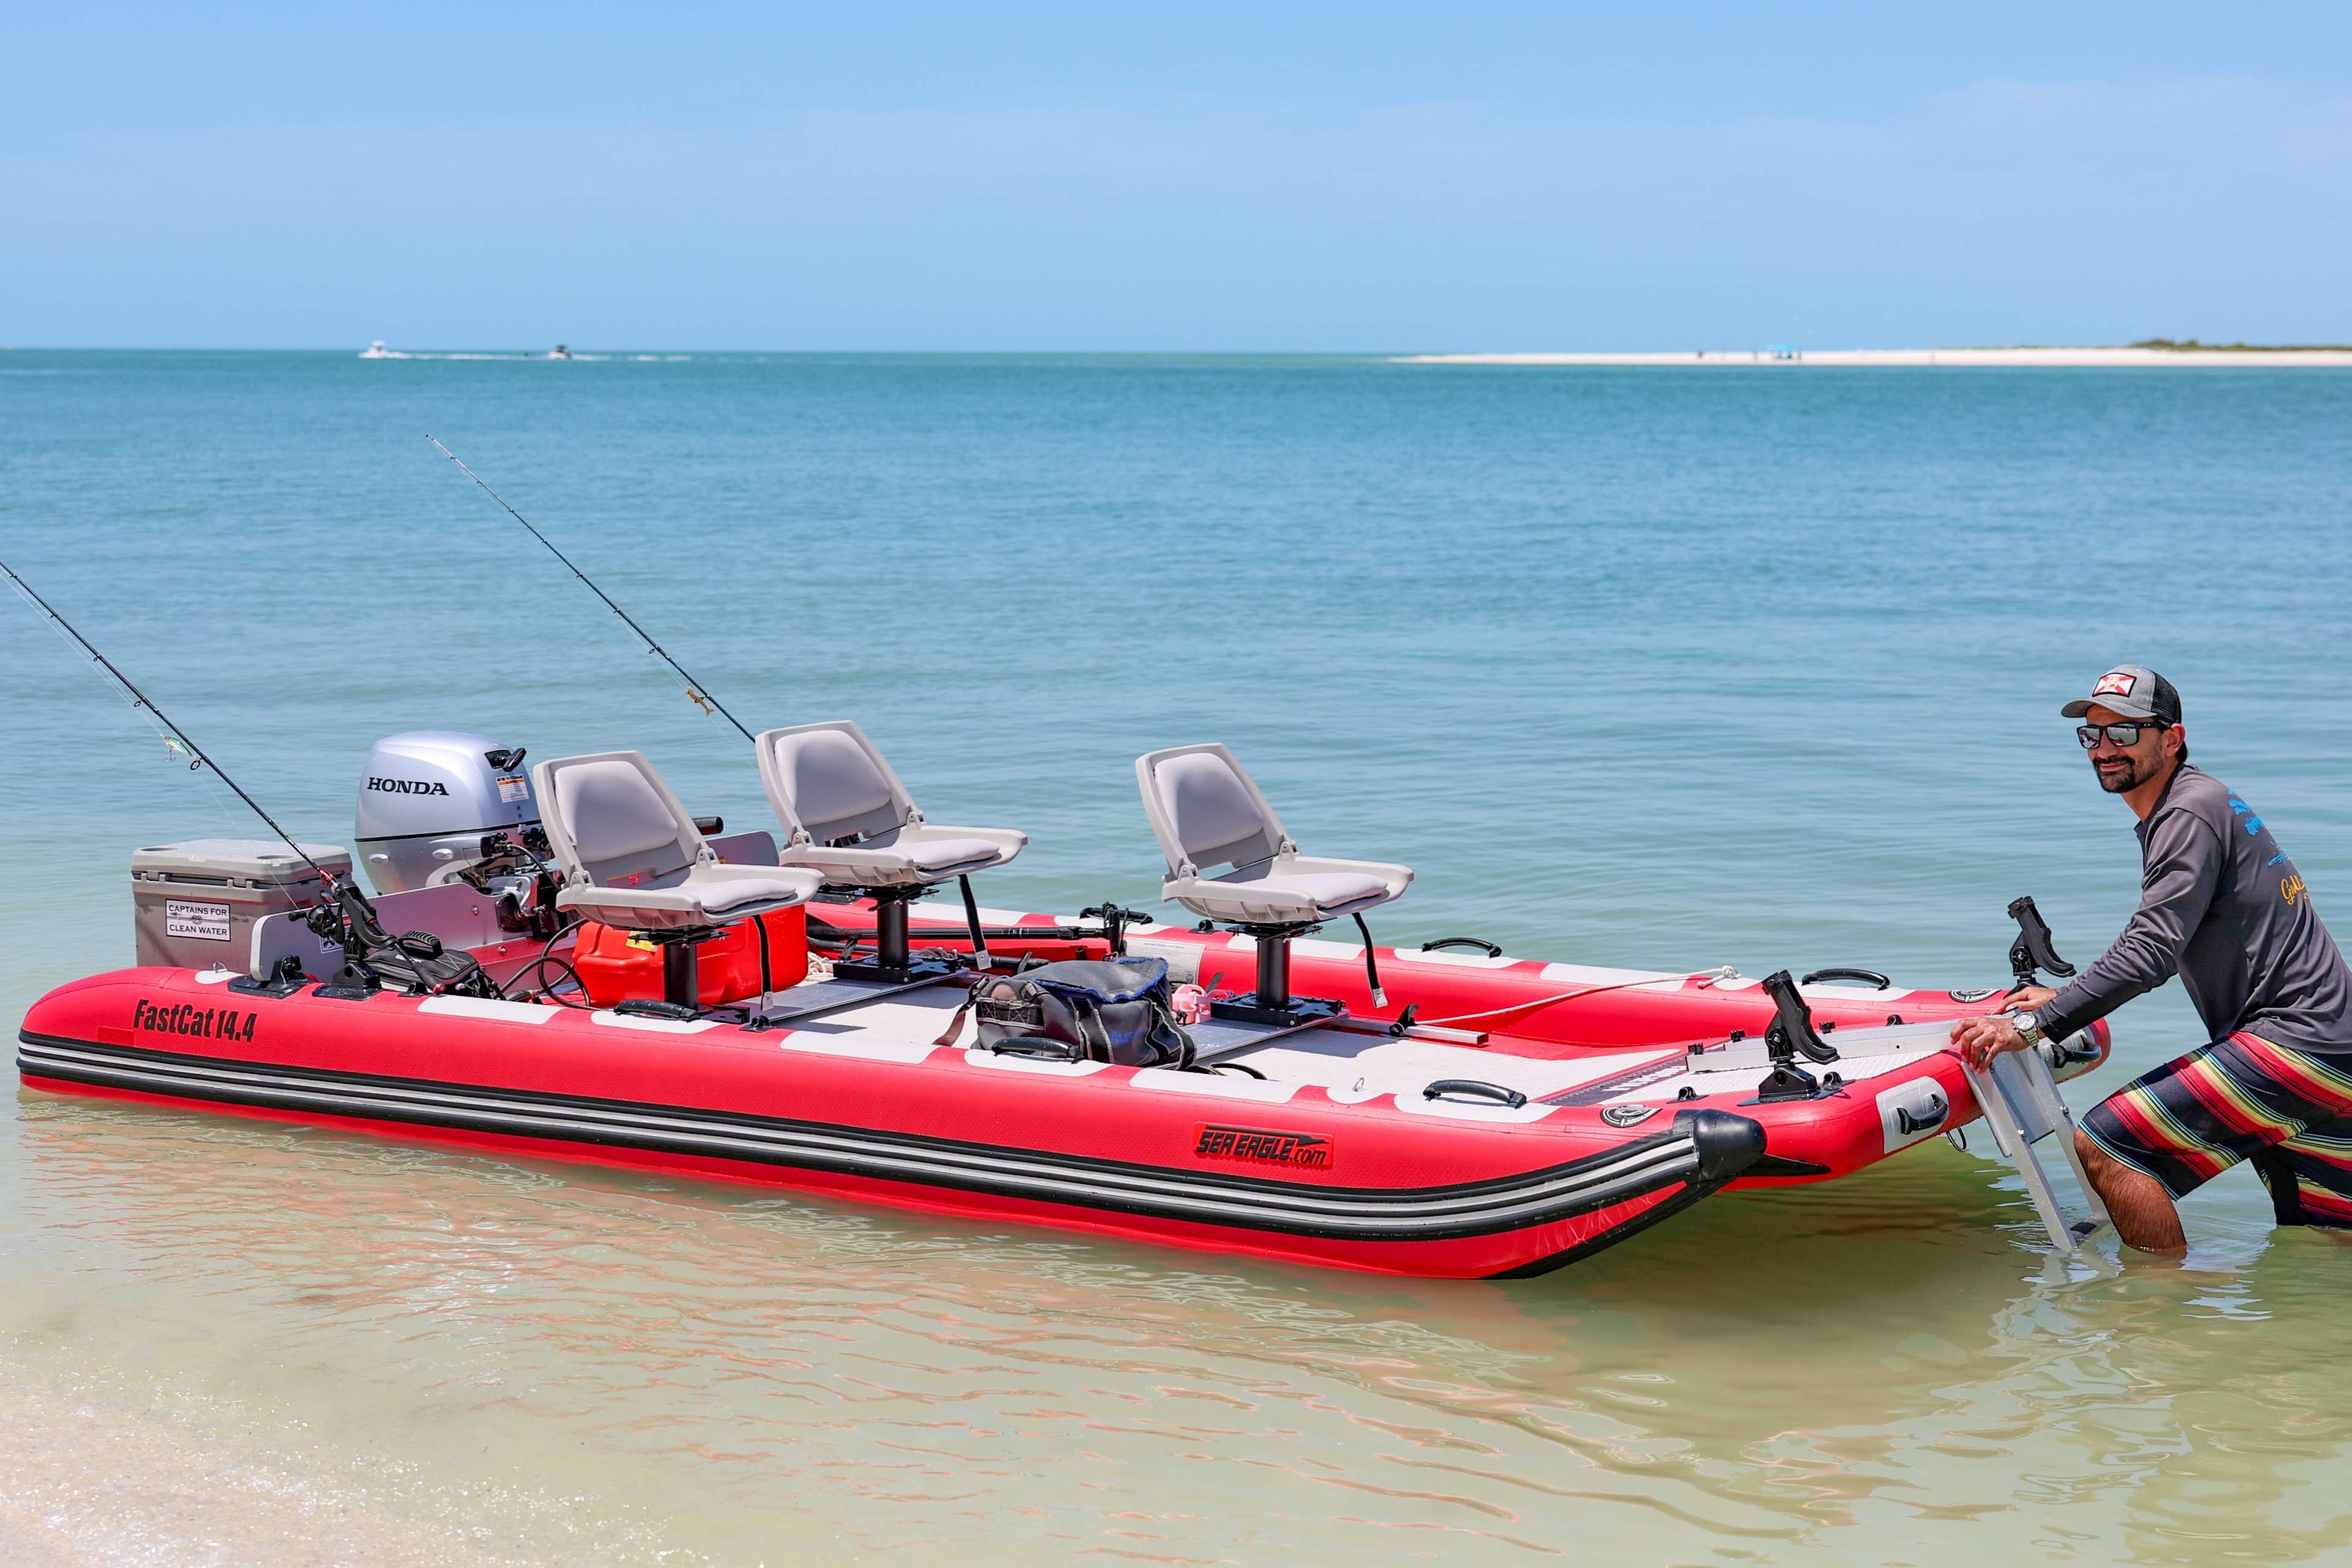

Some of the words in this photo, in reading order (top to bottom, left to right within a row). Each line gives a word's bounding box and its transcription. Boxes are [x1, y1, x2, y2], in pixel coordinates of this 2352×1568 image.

[367, 777, 450, 796] HONDA
[168, 905, 209, 915] CAPTAINS
[169, 924, 197, 933] CLEAN
[198, 926, 227, 936] WATER
[133, 999, 215, 1038] FastCat
[216, 1010, 258, 1042] 14.4
